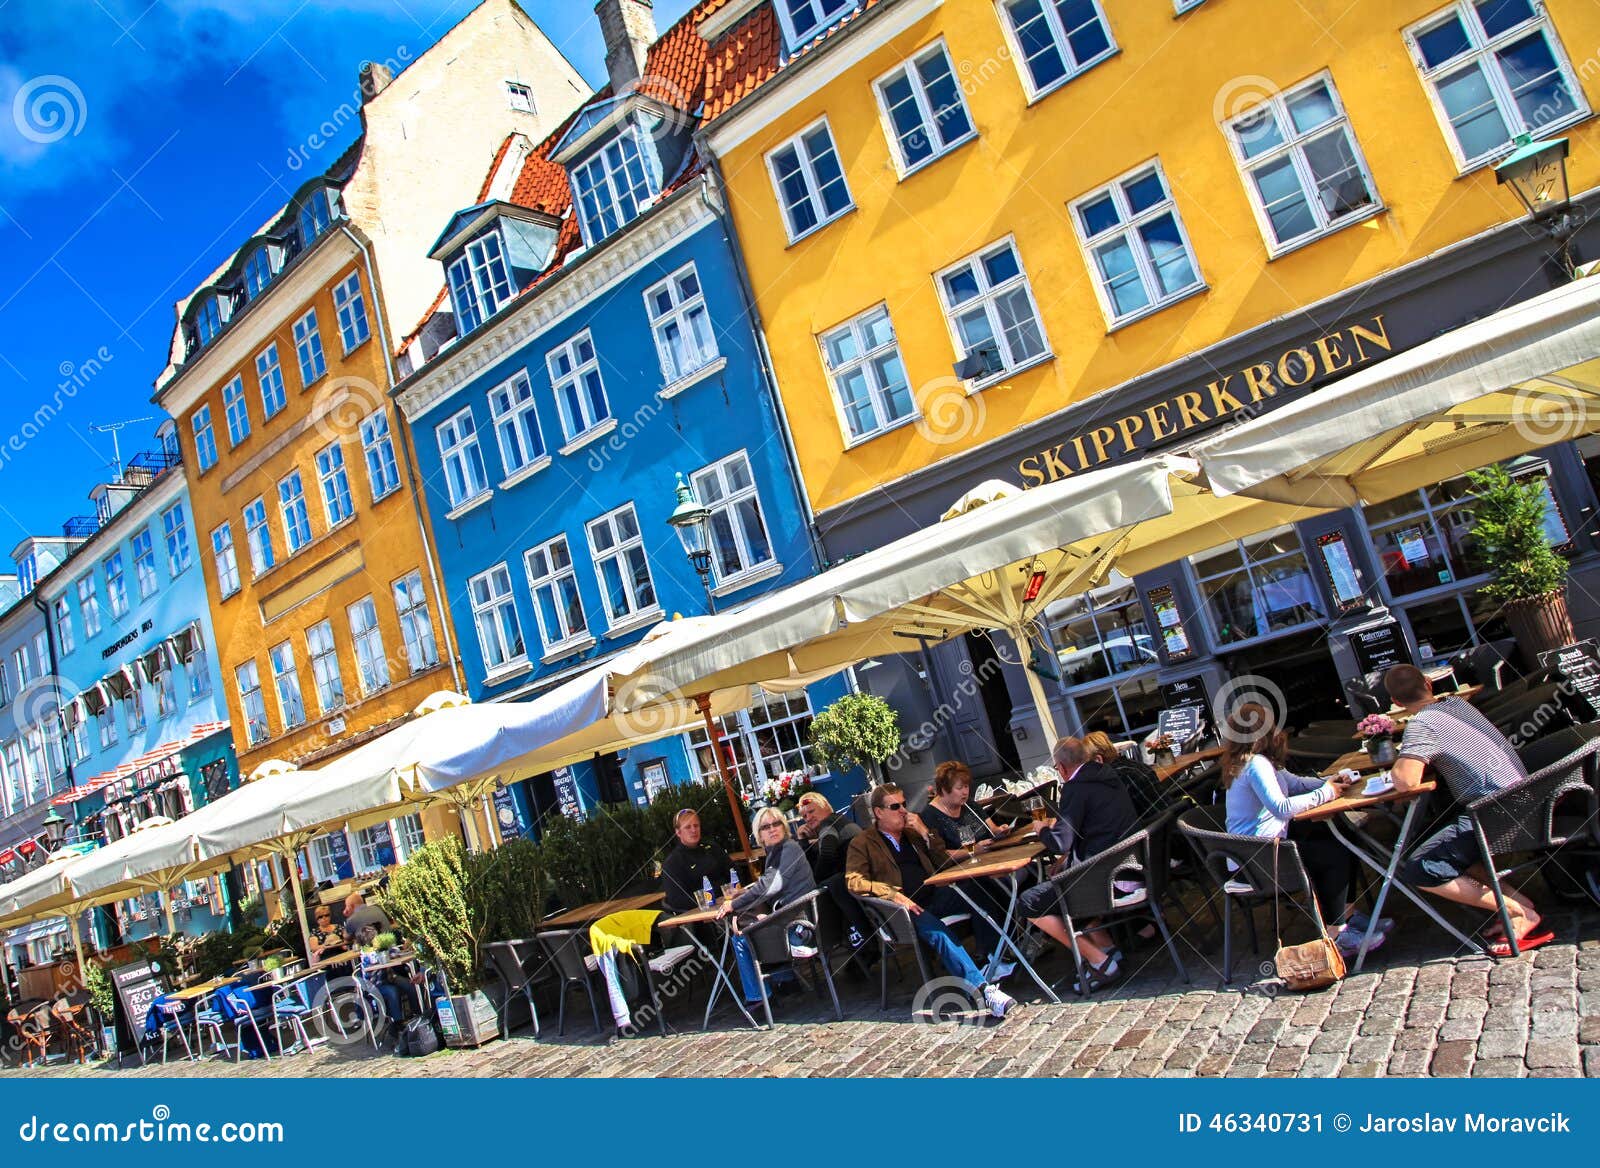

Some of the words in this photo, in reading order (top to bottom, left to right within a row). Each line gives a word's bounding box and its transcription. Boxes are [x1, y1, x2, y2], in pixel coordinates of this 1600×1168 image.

[1520, 157, 1557, 183] No.
[1533, 177, 1556, 201] 27
[1018, 314, 1393, 490] SKIPPERKROEN
[119, 966, 151, 982] TUBORG
[145, 1030, 160, 1041] Kr.
